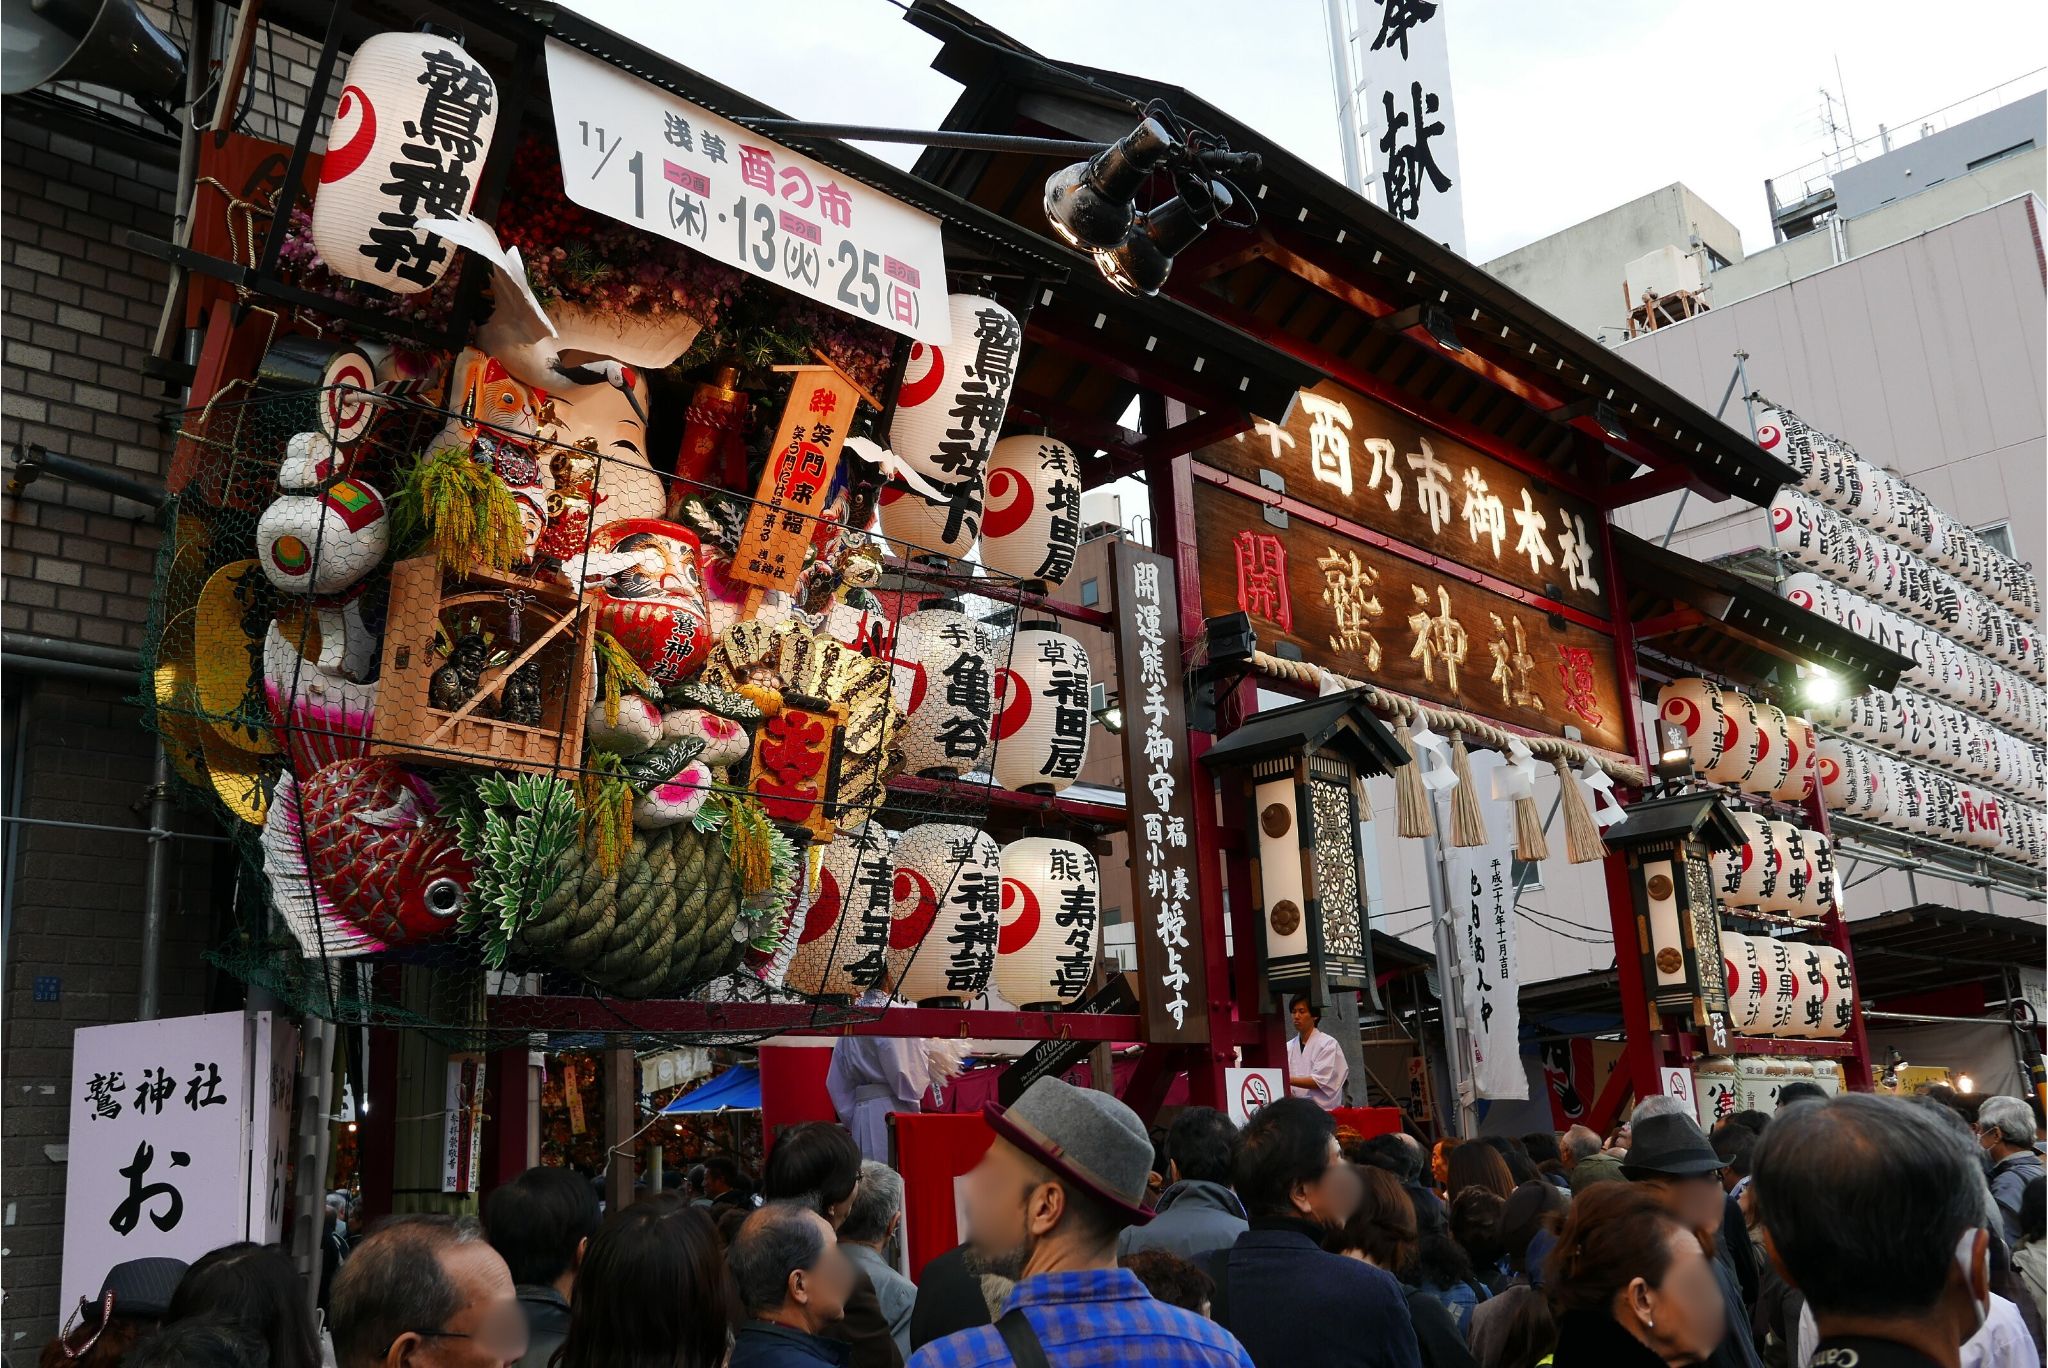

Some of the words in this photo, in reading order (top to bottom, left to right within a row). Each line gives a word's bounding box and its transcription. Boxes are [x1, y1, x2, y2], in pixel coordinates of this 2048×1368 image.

[360, 49, 495, 290] 鷲神社
[664, 111, 728, 165] 浅草
[738, 143, 853, 229] 酉の市
[809, 388, 837, 417] 絆
[929, 308, 1021, 477] 鷲神社
[759, 423, 807, 543] 笑う門には福来る
[781, 421, 835, 535] 笑門来福
[1033, 478, 1081, 587] 増田屋
[1237, 391, 1600, 597] 酉乃市御本社
[652, 609, 699, 682] 鷲神社
[1232, 529, 1293, 635] 開
[1316, 546, 1545, 713] 鷲神社
[1557, 643, 1604, 728] 運
[934, 651, 991, 761] 亀谷
[1039, 670, 1089, 780] 福田屋
[1133, 562, 1176, 812] 開運熊手御守
[1050, 848, 1098, 884] 熊手
[1142, 812, 1169, 900] 酉小判
[843, 857, 894, 987] 青年会
[944, 871, 1000, 993] 福神講
[1050, 884, 1097, 998] 寿々喜
[1156, 901, 1190, 1031] 授与す
[1490, 858, 1509, 980] 平成二十九年十一月吉日
[83, 1062, 228, 1122] 鷲神社
[108, 1139, 192, 1237] お
